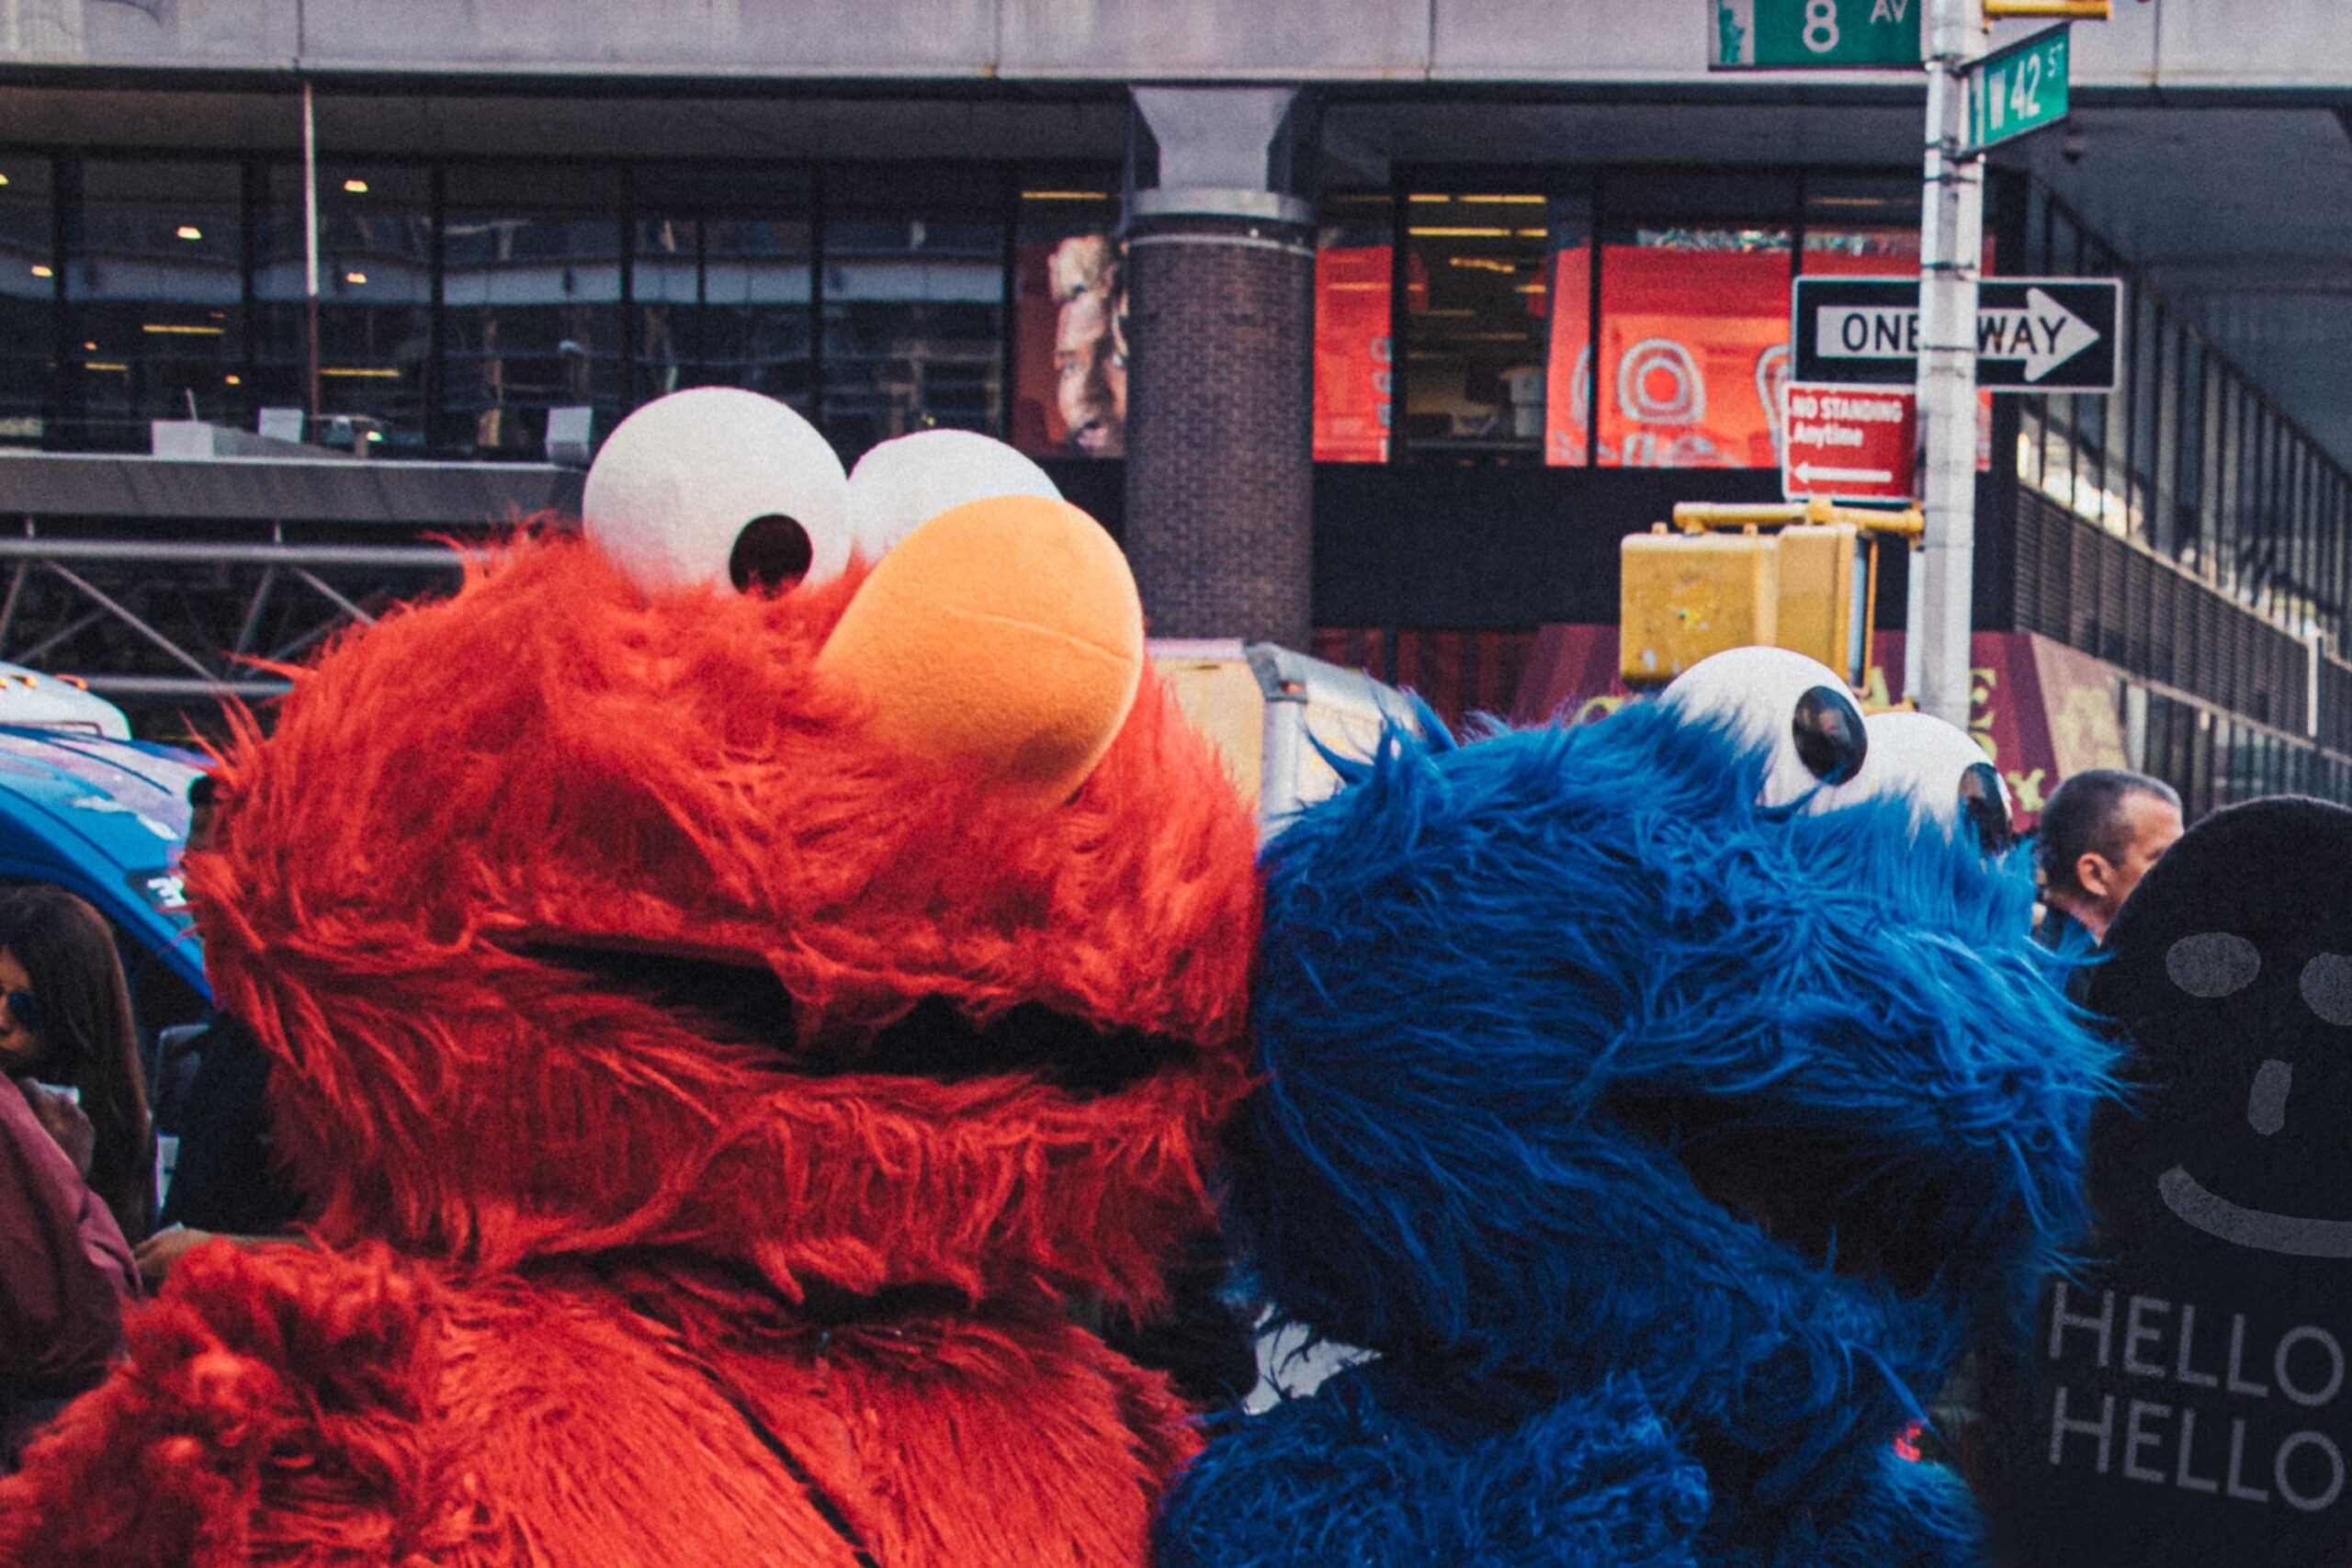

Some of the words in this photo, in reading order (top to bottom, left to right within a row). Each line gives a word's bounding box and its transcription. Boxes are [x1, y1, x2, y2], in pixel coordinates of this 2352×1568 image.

[1803, 0, 1839, 52] 8
[1870, 0, 1907, 24] AV
[1988, 68, 2007, 130] W
[2010, 52, 2041, 120] 42
[2047, 42, 2065, 78] ST
[1976, 315, 2067, 355] WAY
[1792, 395, 1818, 419] NO
[1820, 397, 1903, 423] STANDING
[1792, 422, 1864, 448] Anytime
[2049, 1281, 2345, 1406] HELLO
[2049, 1386, 2345, 1511] HELLO
